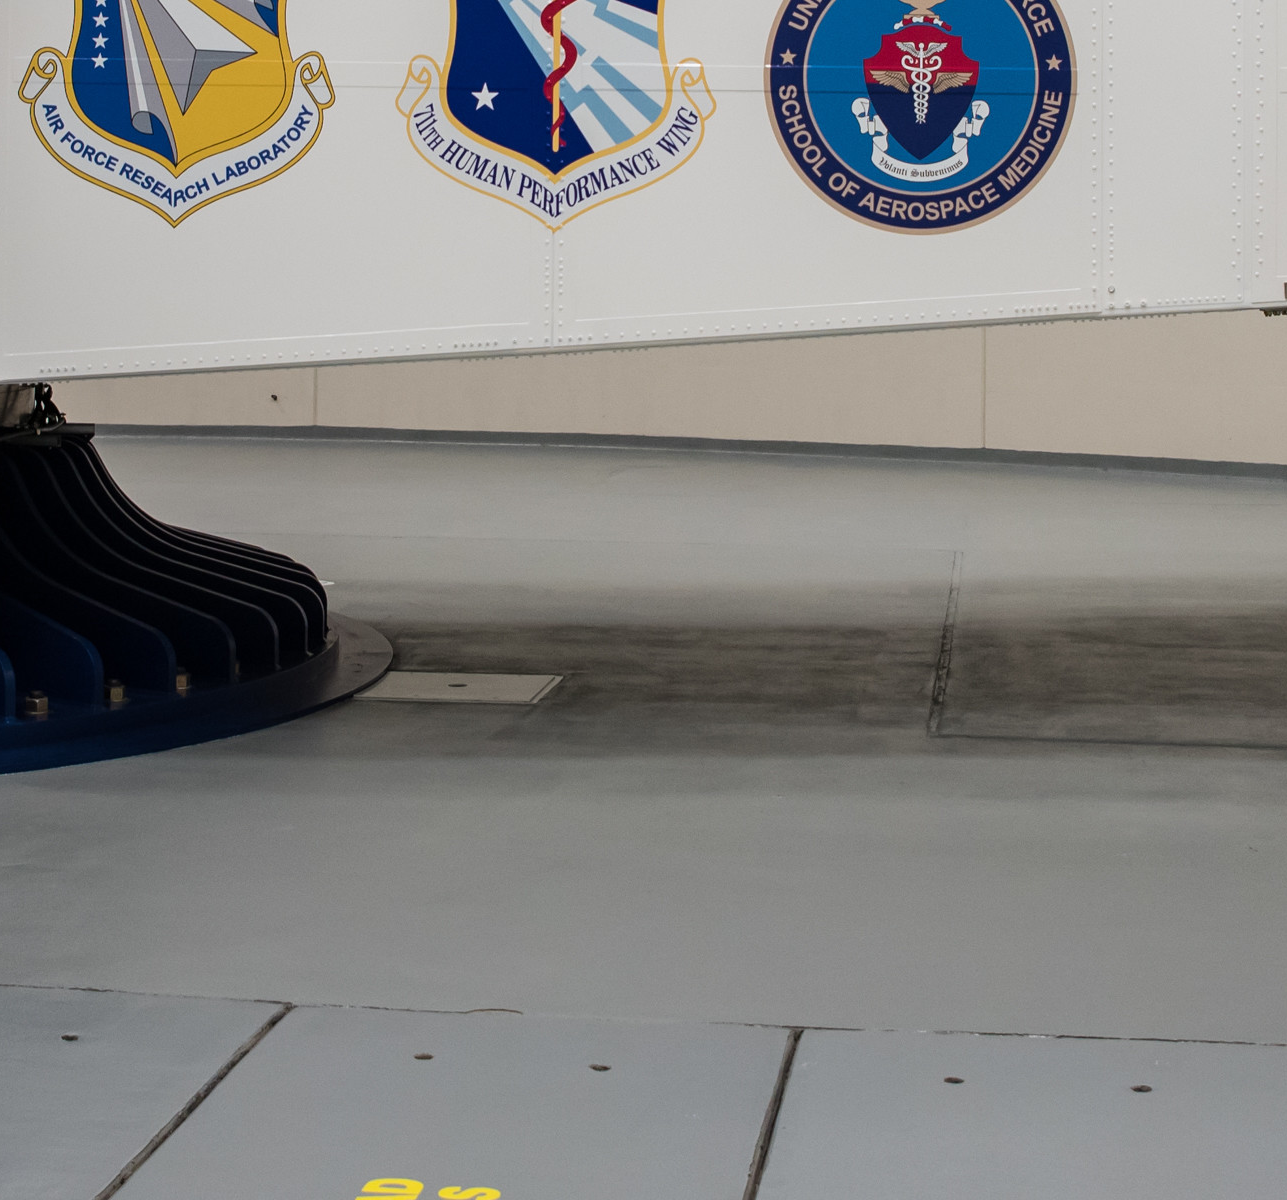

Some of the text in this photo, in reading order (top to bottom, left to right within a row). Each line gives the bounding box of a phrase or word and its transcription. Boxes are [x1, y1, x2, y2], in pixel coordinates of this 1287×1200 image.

[42, 103, 314, 208] AIR FORCE RESEARCH LABORATORY
[413, 103, 699, 218] 711TH HUMAN PERFORMANCE WING
[779, 84, 1063, 221] SCHOOL OF AEROSPACE MEDICINE
